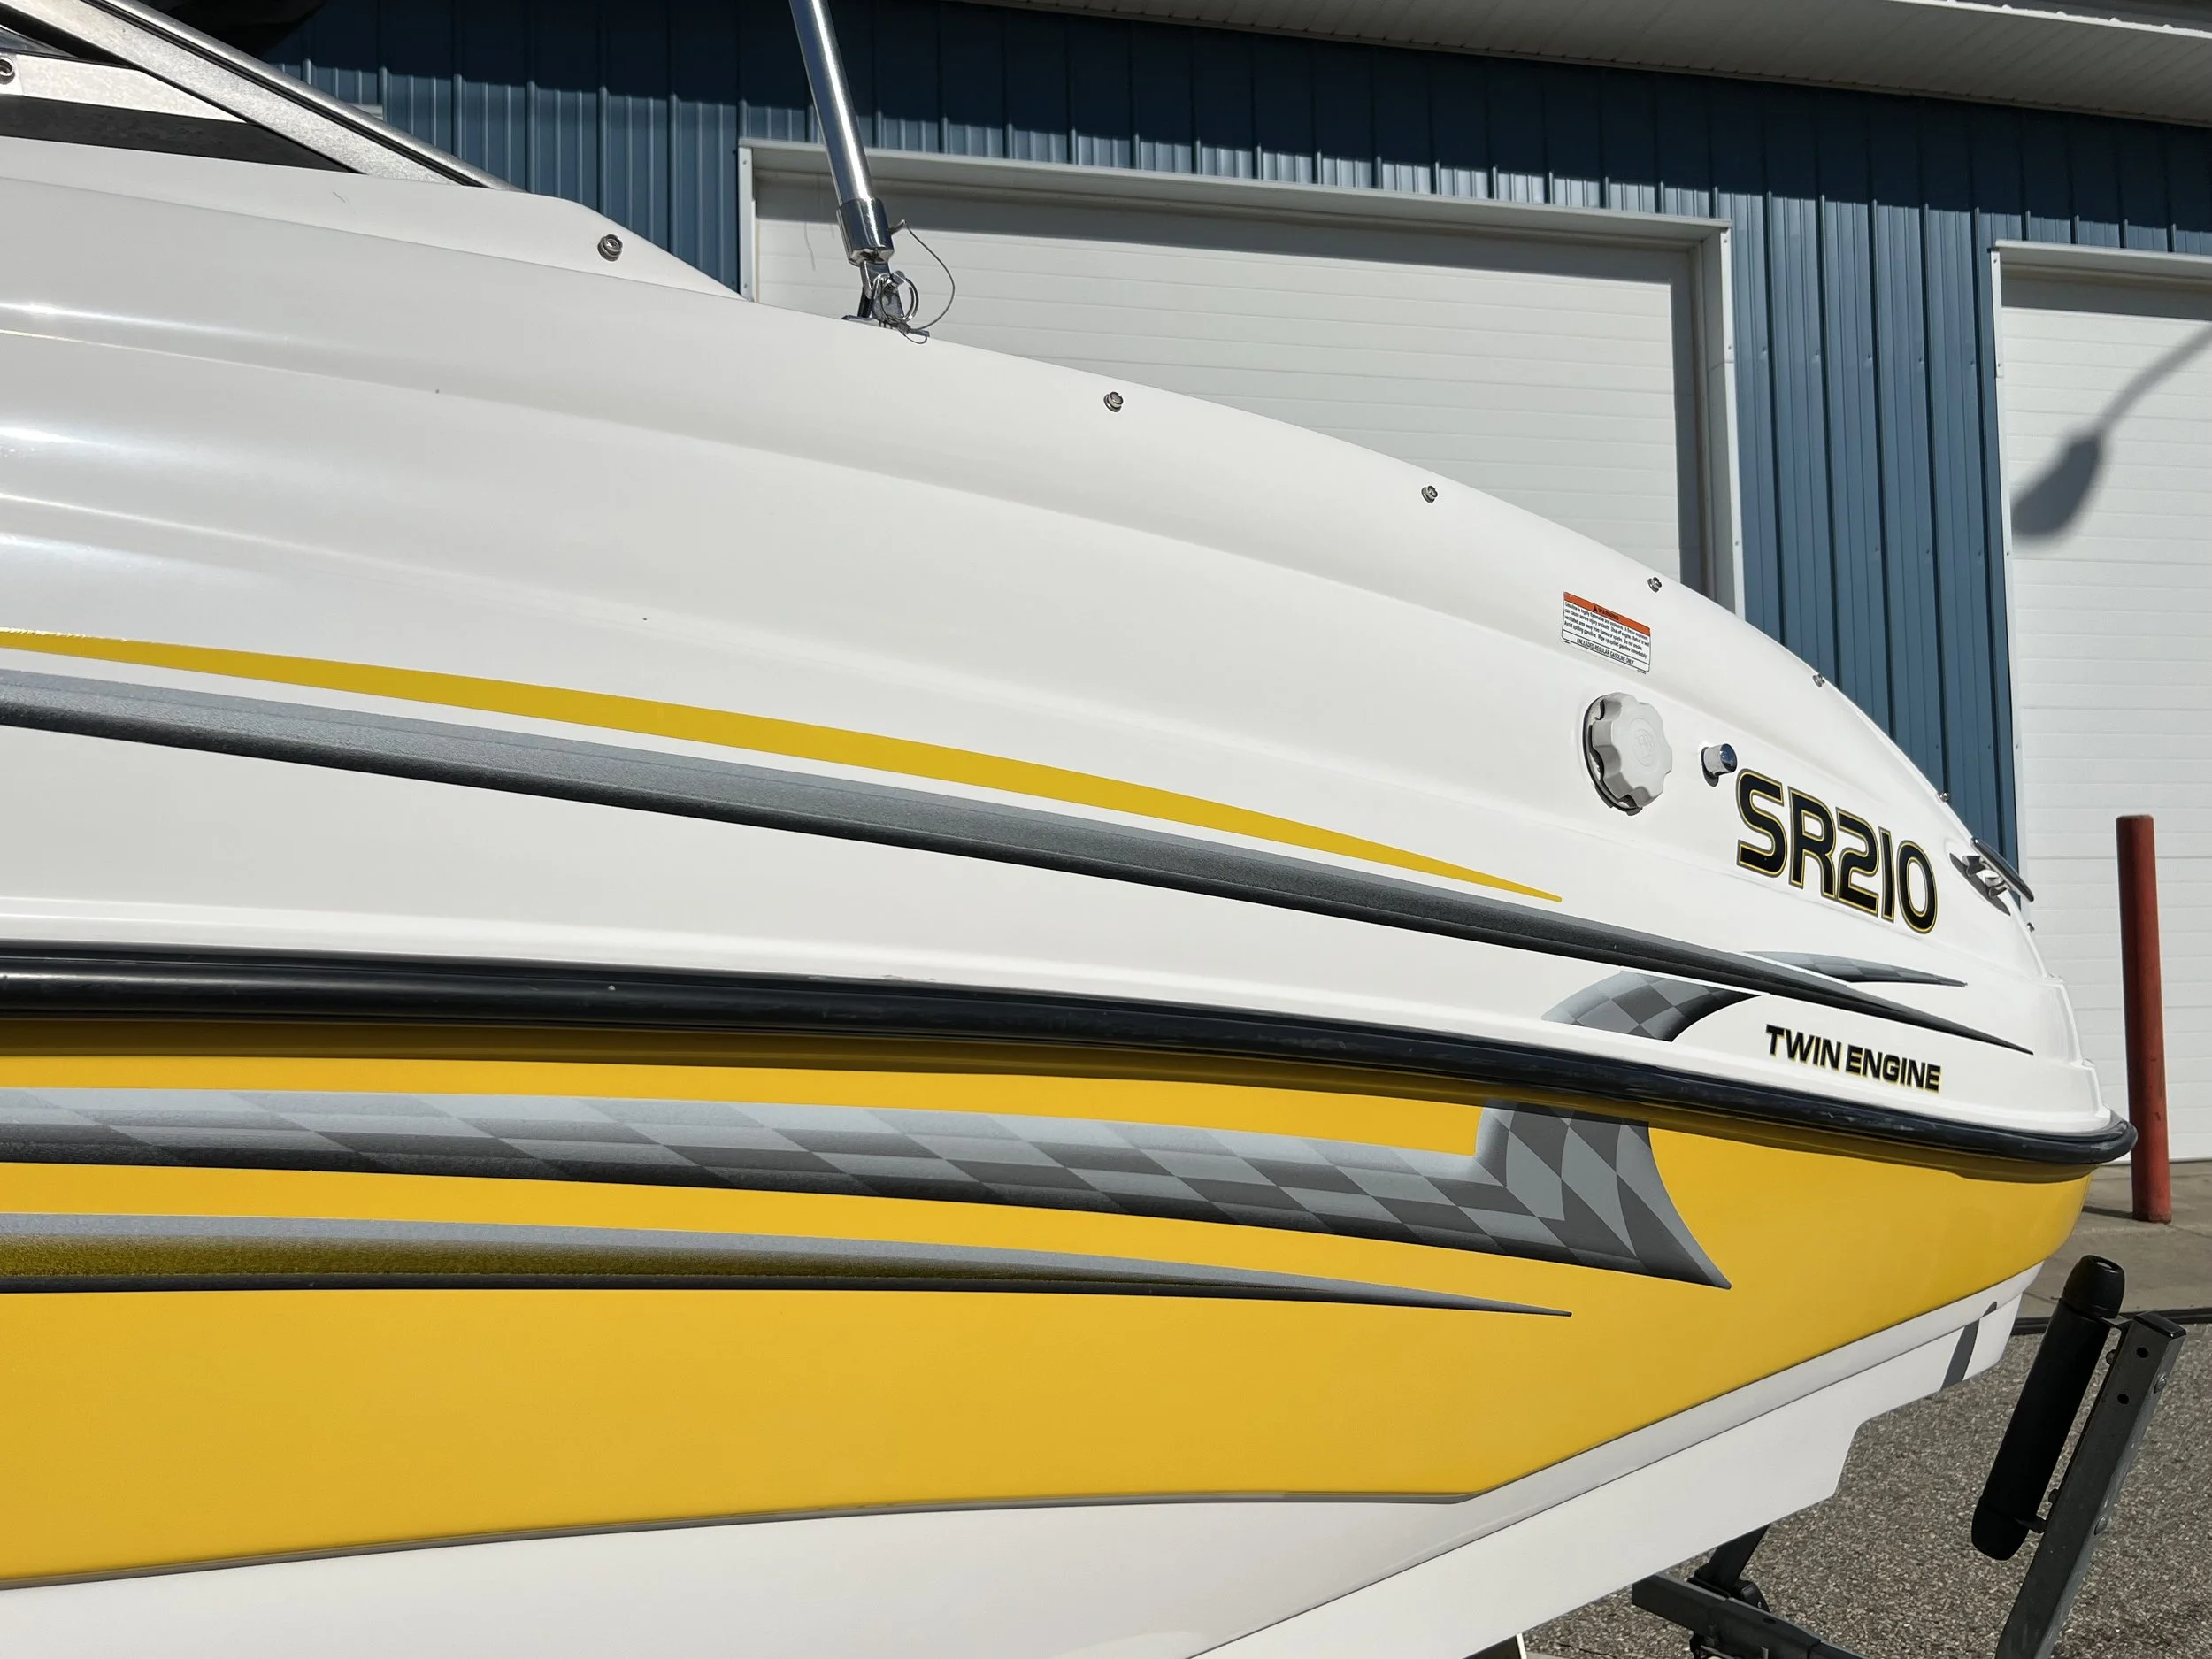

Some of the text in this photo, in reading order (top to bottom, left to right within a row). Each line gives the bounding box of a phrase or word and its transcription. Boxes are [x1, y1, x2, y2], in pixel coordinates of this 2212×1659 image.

[1735, 768, 1938, 934] SR210
[1765, 1024, 1941, 1092] TWIN ENGINE
